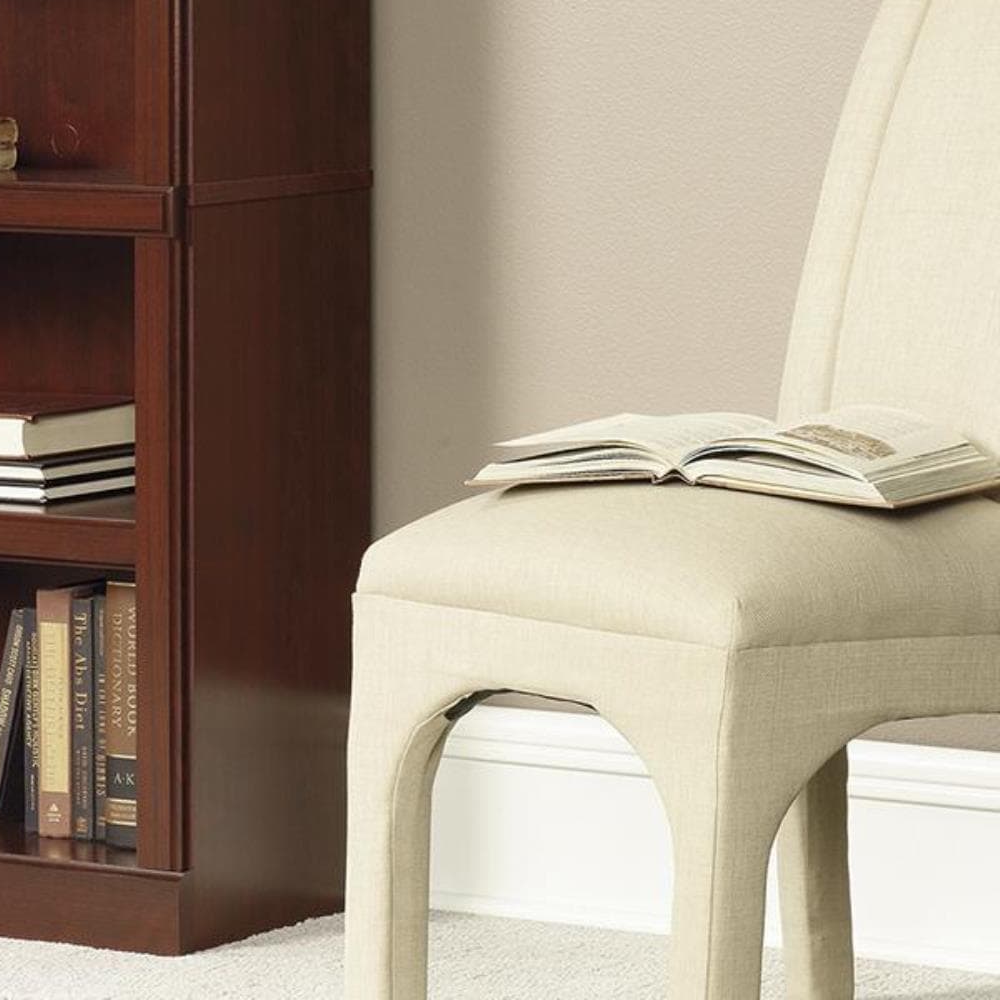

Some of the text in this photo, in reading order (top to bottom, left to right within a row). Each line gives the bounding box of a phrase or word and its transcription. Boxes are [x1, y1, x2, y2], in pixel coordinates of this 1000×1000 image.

[73, 612, 87, 646] The
[74, 652, 87, 685] Abs
[111, 612, 123, 728] DICTIONARY
[126, 606, 137, 737] WORLD BOOK
[75, 692, 88, 729] Diet
